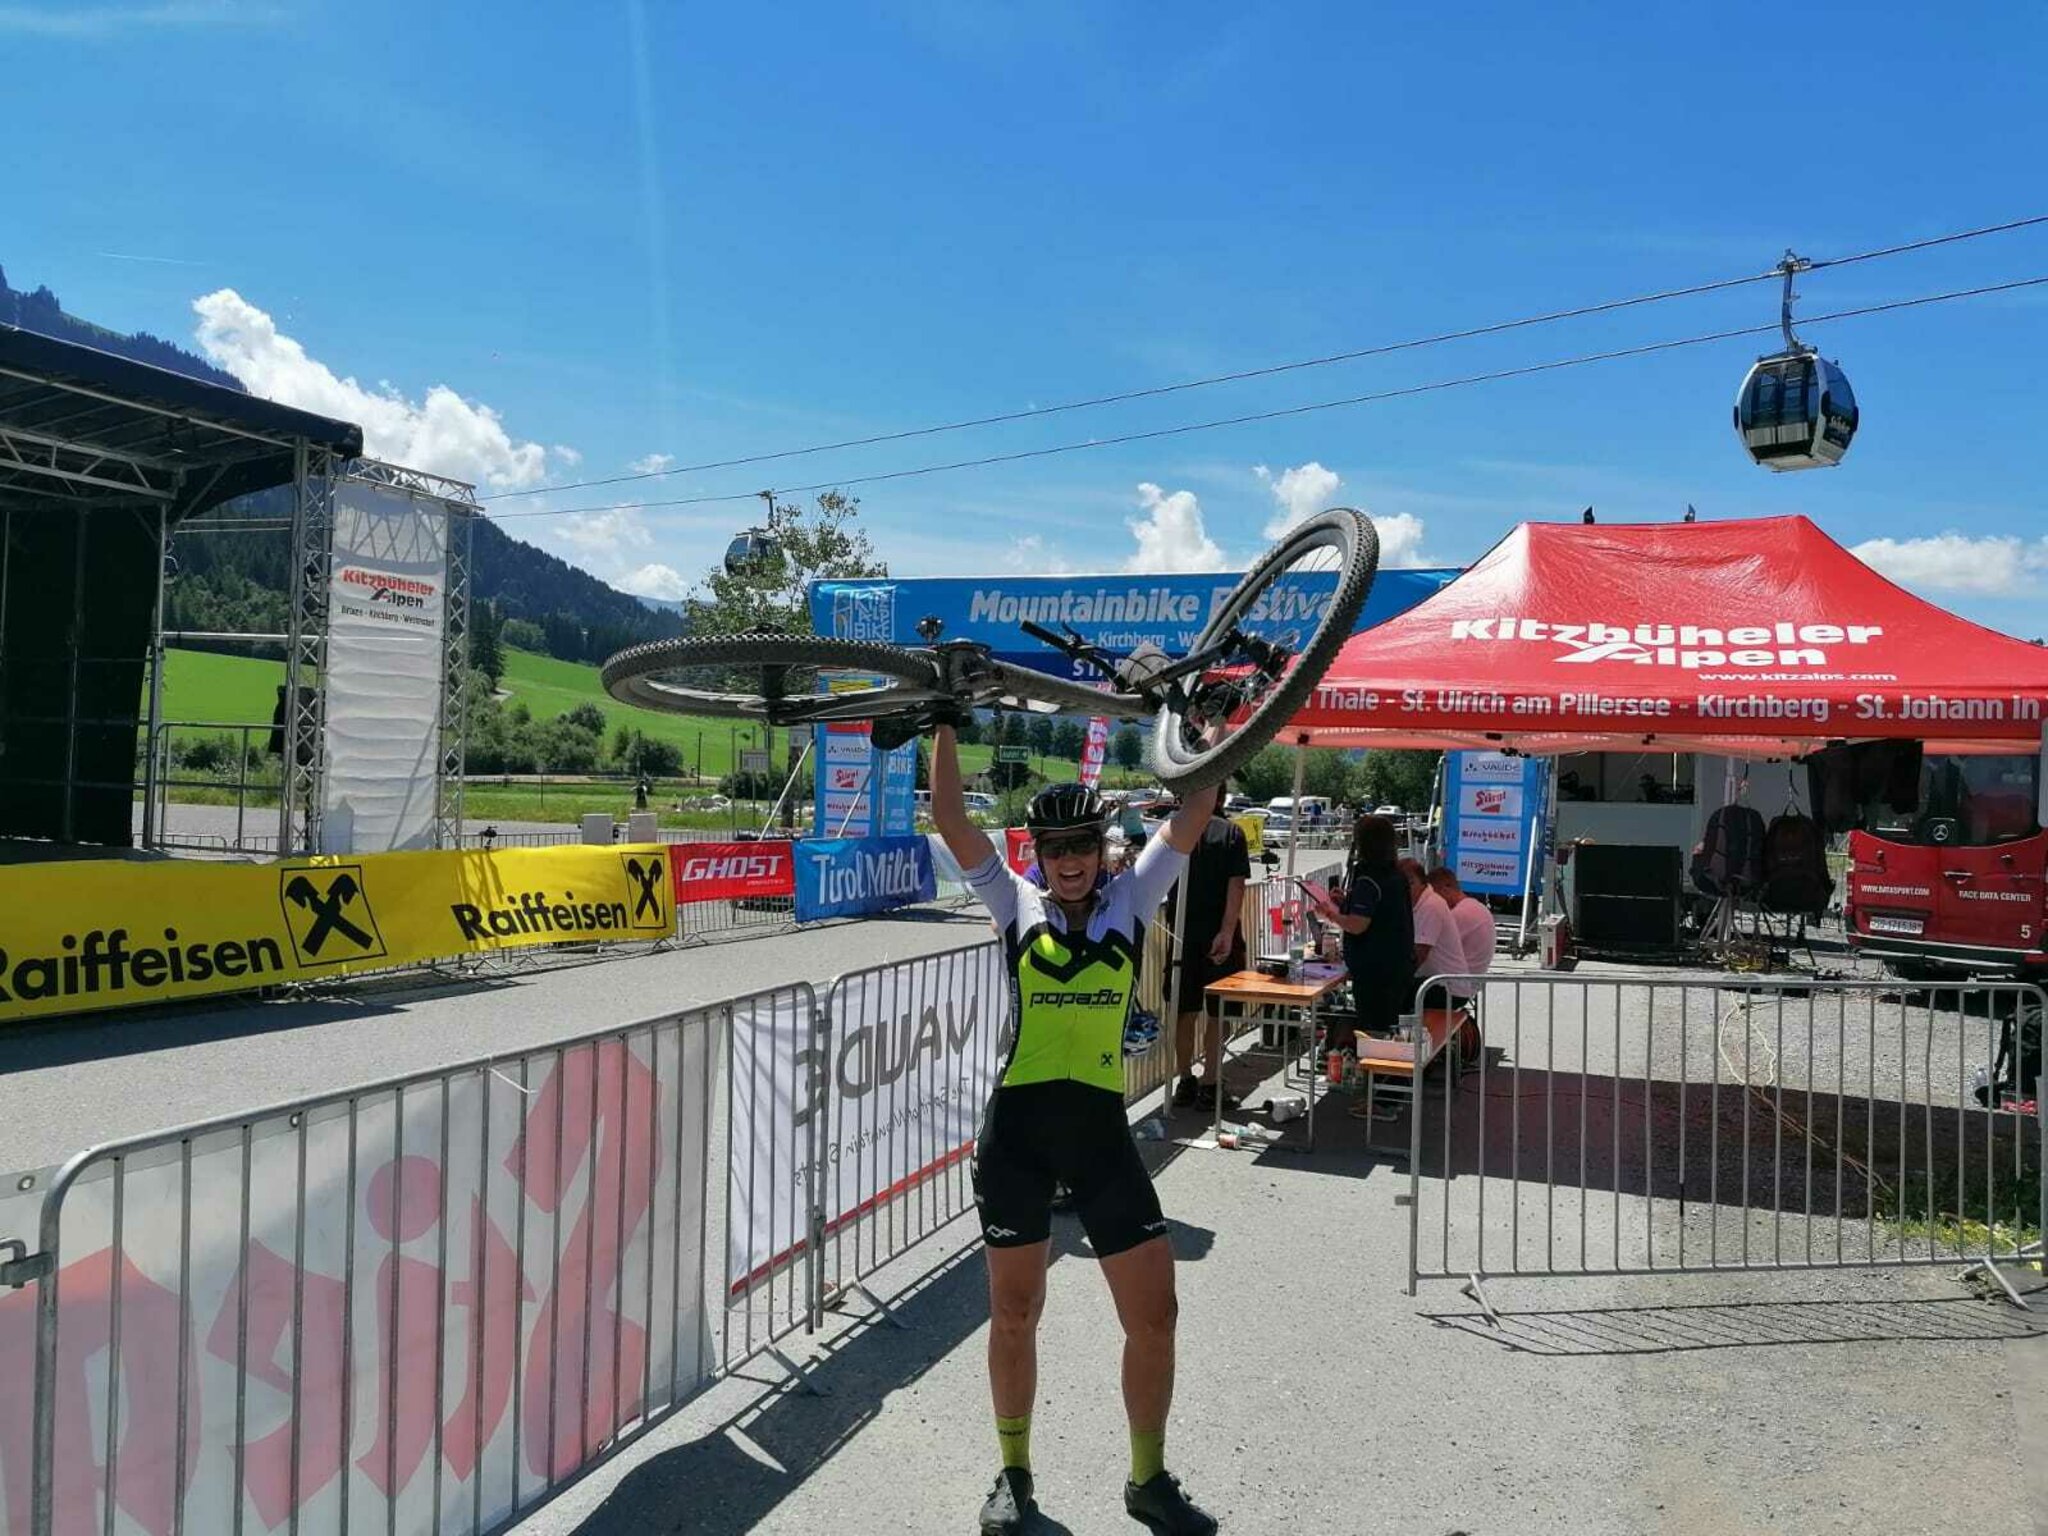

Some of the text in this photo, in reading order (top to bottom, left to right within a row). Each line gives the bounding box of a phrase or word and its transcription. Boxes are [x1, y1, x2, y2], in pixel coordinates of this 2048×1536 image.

[969, 588, 1200, 624] Mountainbike
[1099, 630, 1165, 650] Kirchberg
[1450, 617, 1885, 648] Kitzbüheler
[1553, 642, 1827, 669] Alpen
[1698, 671, 1898, 683] www.kitzalps.com
[1319, 686, 1379, 711] Thale
[1401, 688, 1431, 713] St.
[1437, 689, 1506, 714] Ulrich
[1512, 695, 1551, 715] am
[1559, 692, 1671, 717] Pillersee
[1698, 694, 1829, 723] Kirchberg
[2012, 694, 2040, 720] in
[682, 855, 784, 882] GHOST
[2000, 893, 2031, 902] CENTER
[450, 891, 628, 941] Raiffeisen
[2020, 924, 2032, 939] 5
